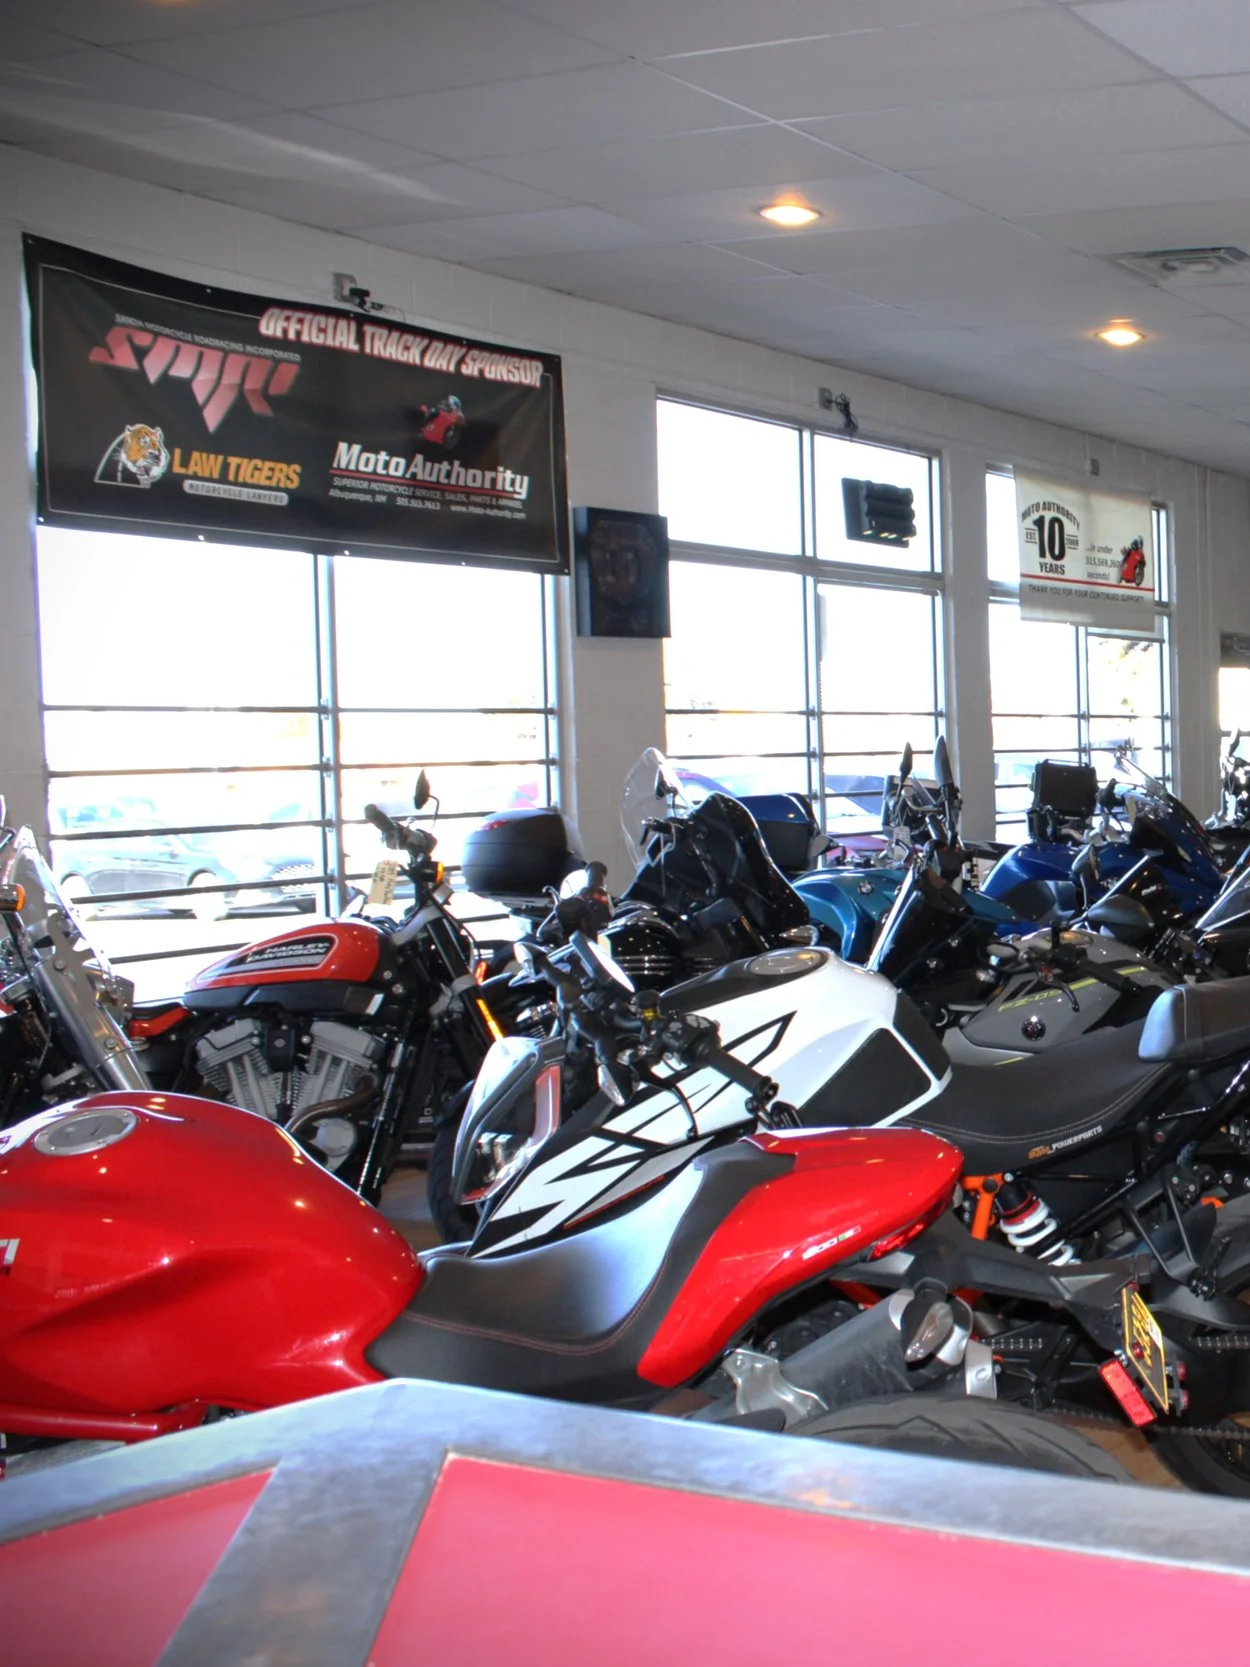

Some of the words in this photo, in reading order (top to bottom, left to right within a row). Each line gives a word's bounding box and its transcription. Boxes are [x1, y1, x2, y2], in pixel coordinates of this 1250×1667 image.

[259, 307, 359, 352] OFFICIAL
[362, 323, 428, 366] TRACK
[423, 337, 467, 374] DAY
[460, 348, 544, 389] SPONSOR
[172, 447, 224, 479] LAW
[226, 456, 302, 489] TIGERS
[188, 483, 243, 499] MOTORCYCLE
[246, 489, 285, 504] LAWYERS
[1021, 501, 1041, 522] MOTO
[1041, 500, 1080, 531] AUTHORITY
[1032, 514, 1066, 561] 10
[1039, 562, 1065, 576] YEARS
[1050, 586, 1061, 596] YOU
[1063, 587, 1073, 597] FOR
[247, 947, 328, 963] DAVIDSON
